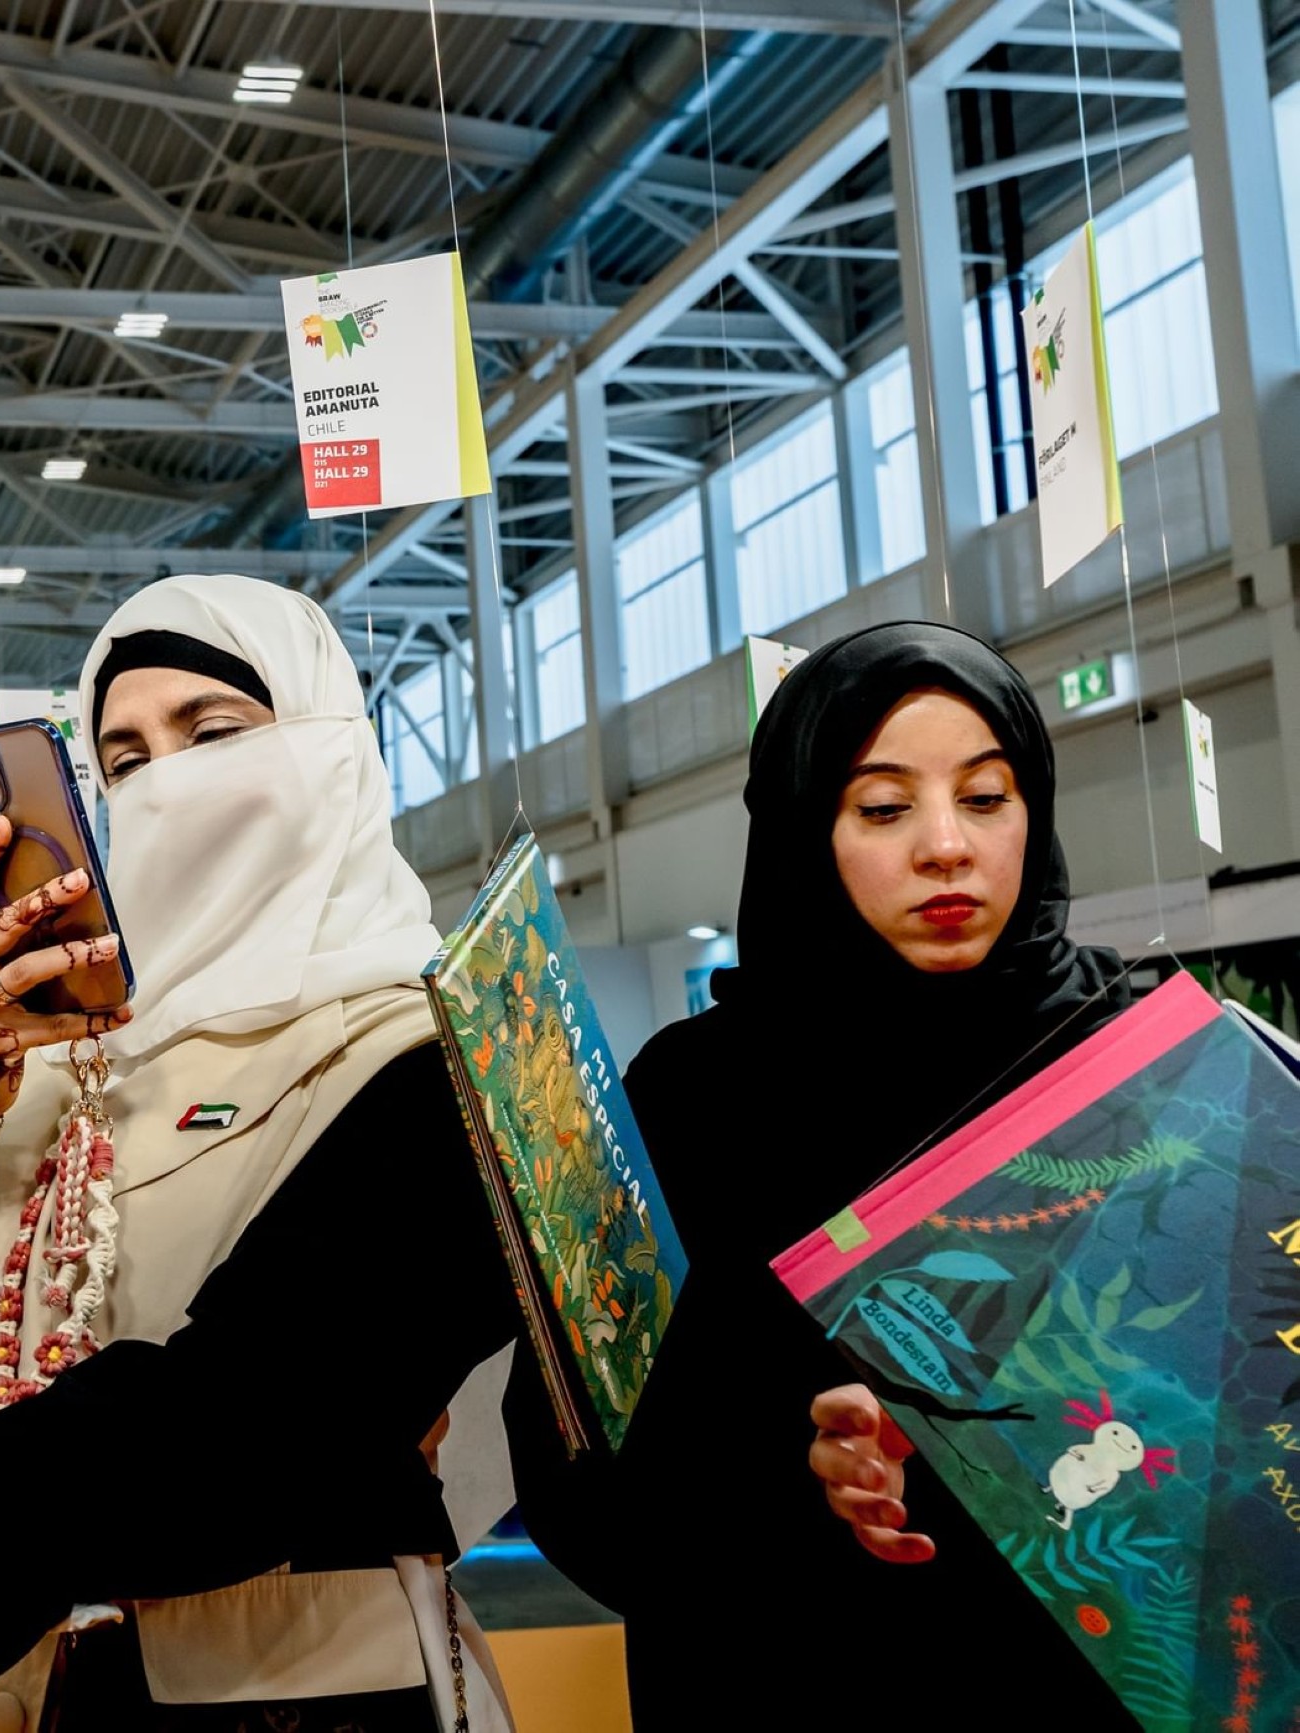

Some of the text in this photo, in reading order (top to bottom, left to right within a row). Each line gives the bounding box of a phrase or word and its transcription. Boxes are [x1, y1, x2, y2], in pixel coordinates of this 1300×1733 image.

[304, 381, 380, 403] EDITORIAL
[305, 395, 380, 418] AMANUTA
[307, 419, 347, 437] CHILE
[314, 444, 368, 458] HALL 29
[314, 466, 369, 480] HALL 29
[591, 1048, 612, 1093] MI
[547, 951, 650, 1228] CASA ESPECIAL
[902, 1286, 957, 1338] Linda
[861, 1300, 953, 1393] Bondestam
